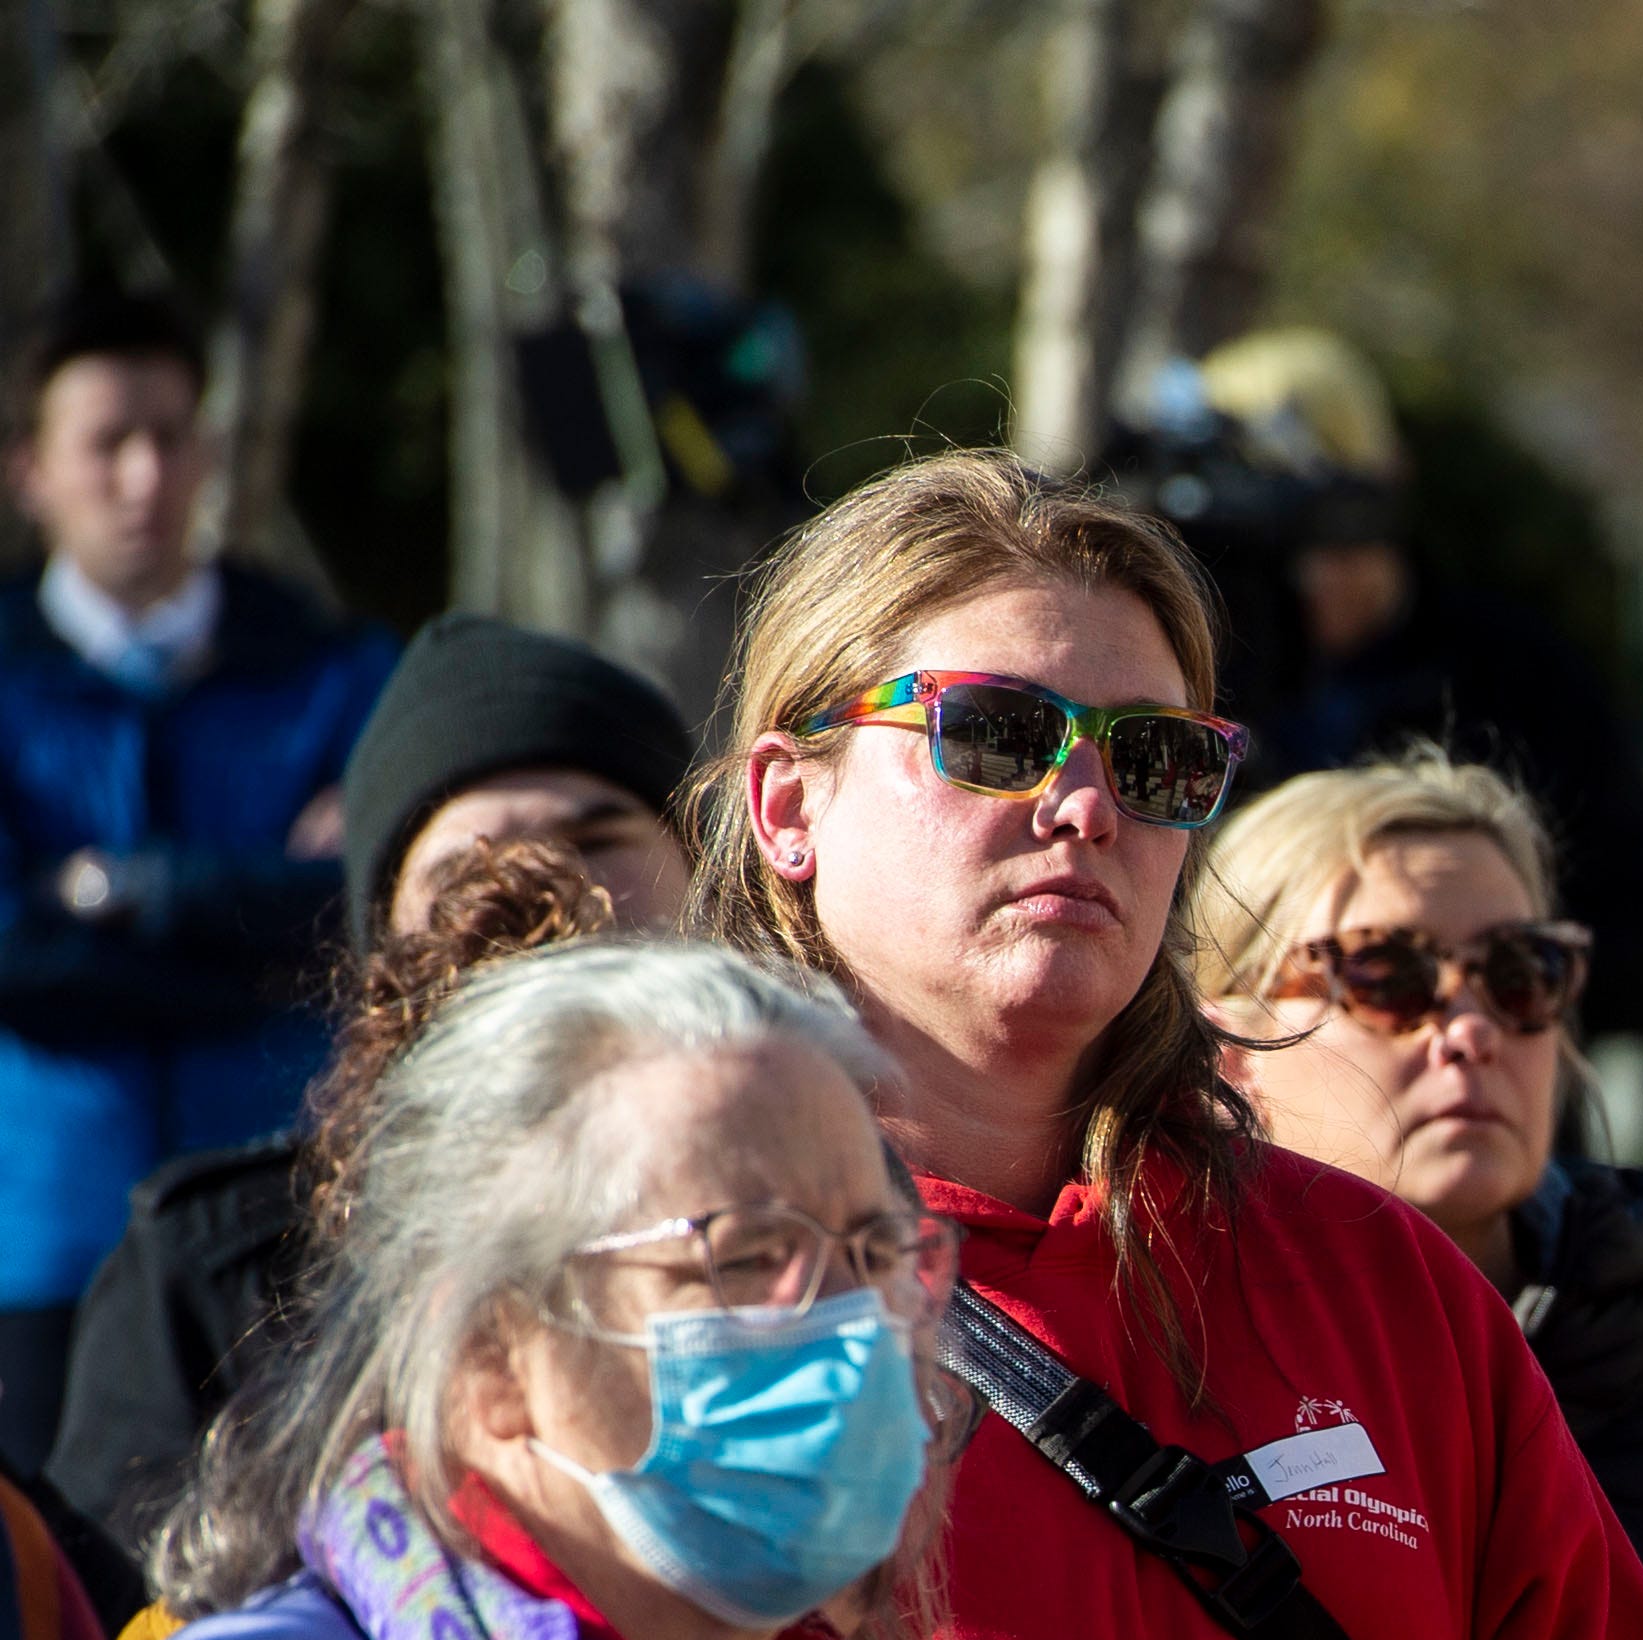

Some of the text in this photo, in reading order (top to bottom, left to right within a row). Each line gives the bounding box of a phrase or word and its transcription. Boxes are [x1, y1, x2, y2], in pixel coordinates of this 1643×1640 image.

[1284, 1487, 1338, 1503] cial
[1286, 1509, 1418, 1550] North Carolina
